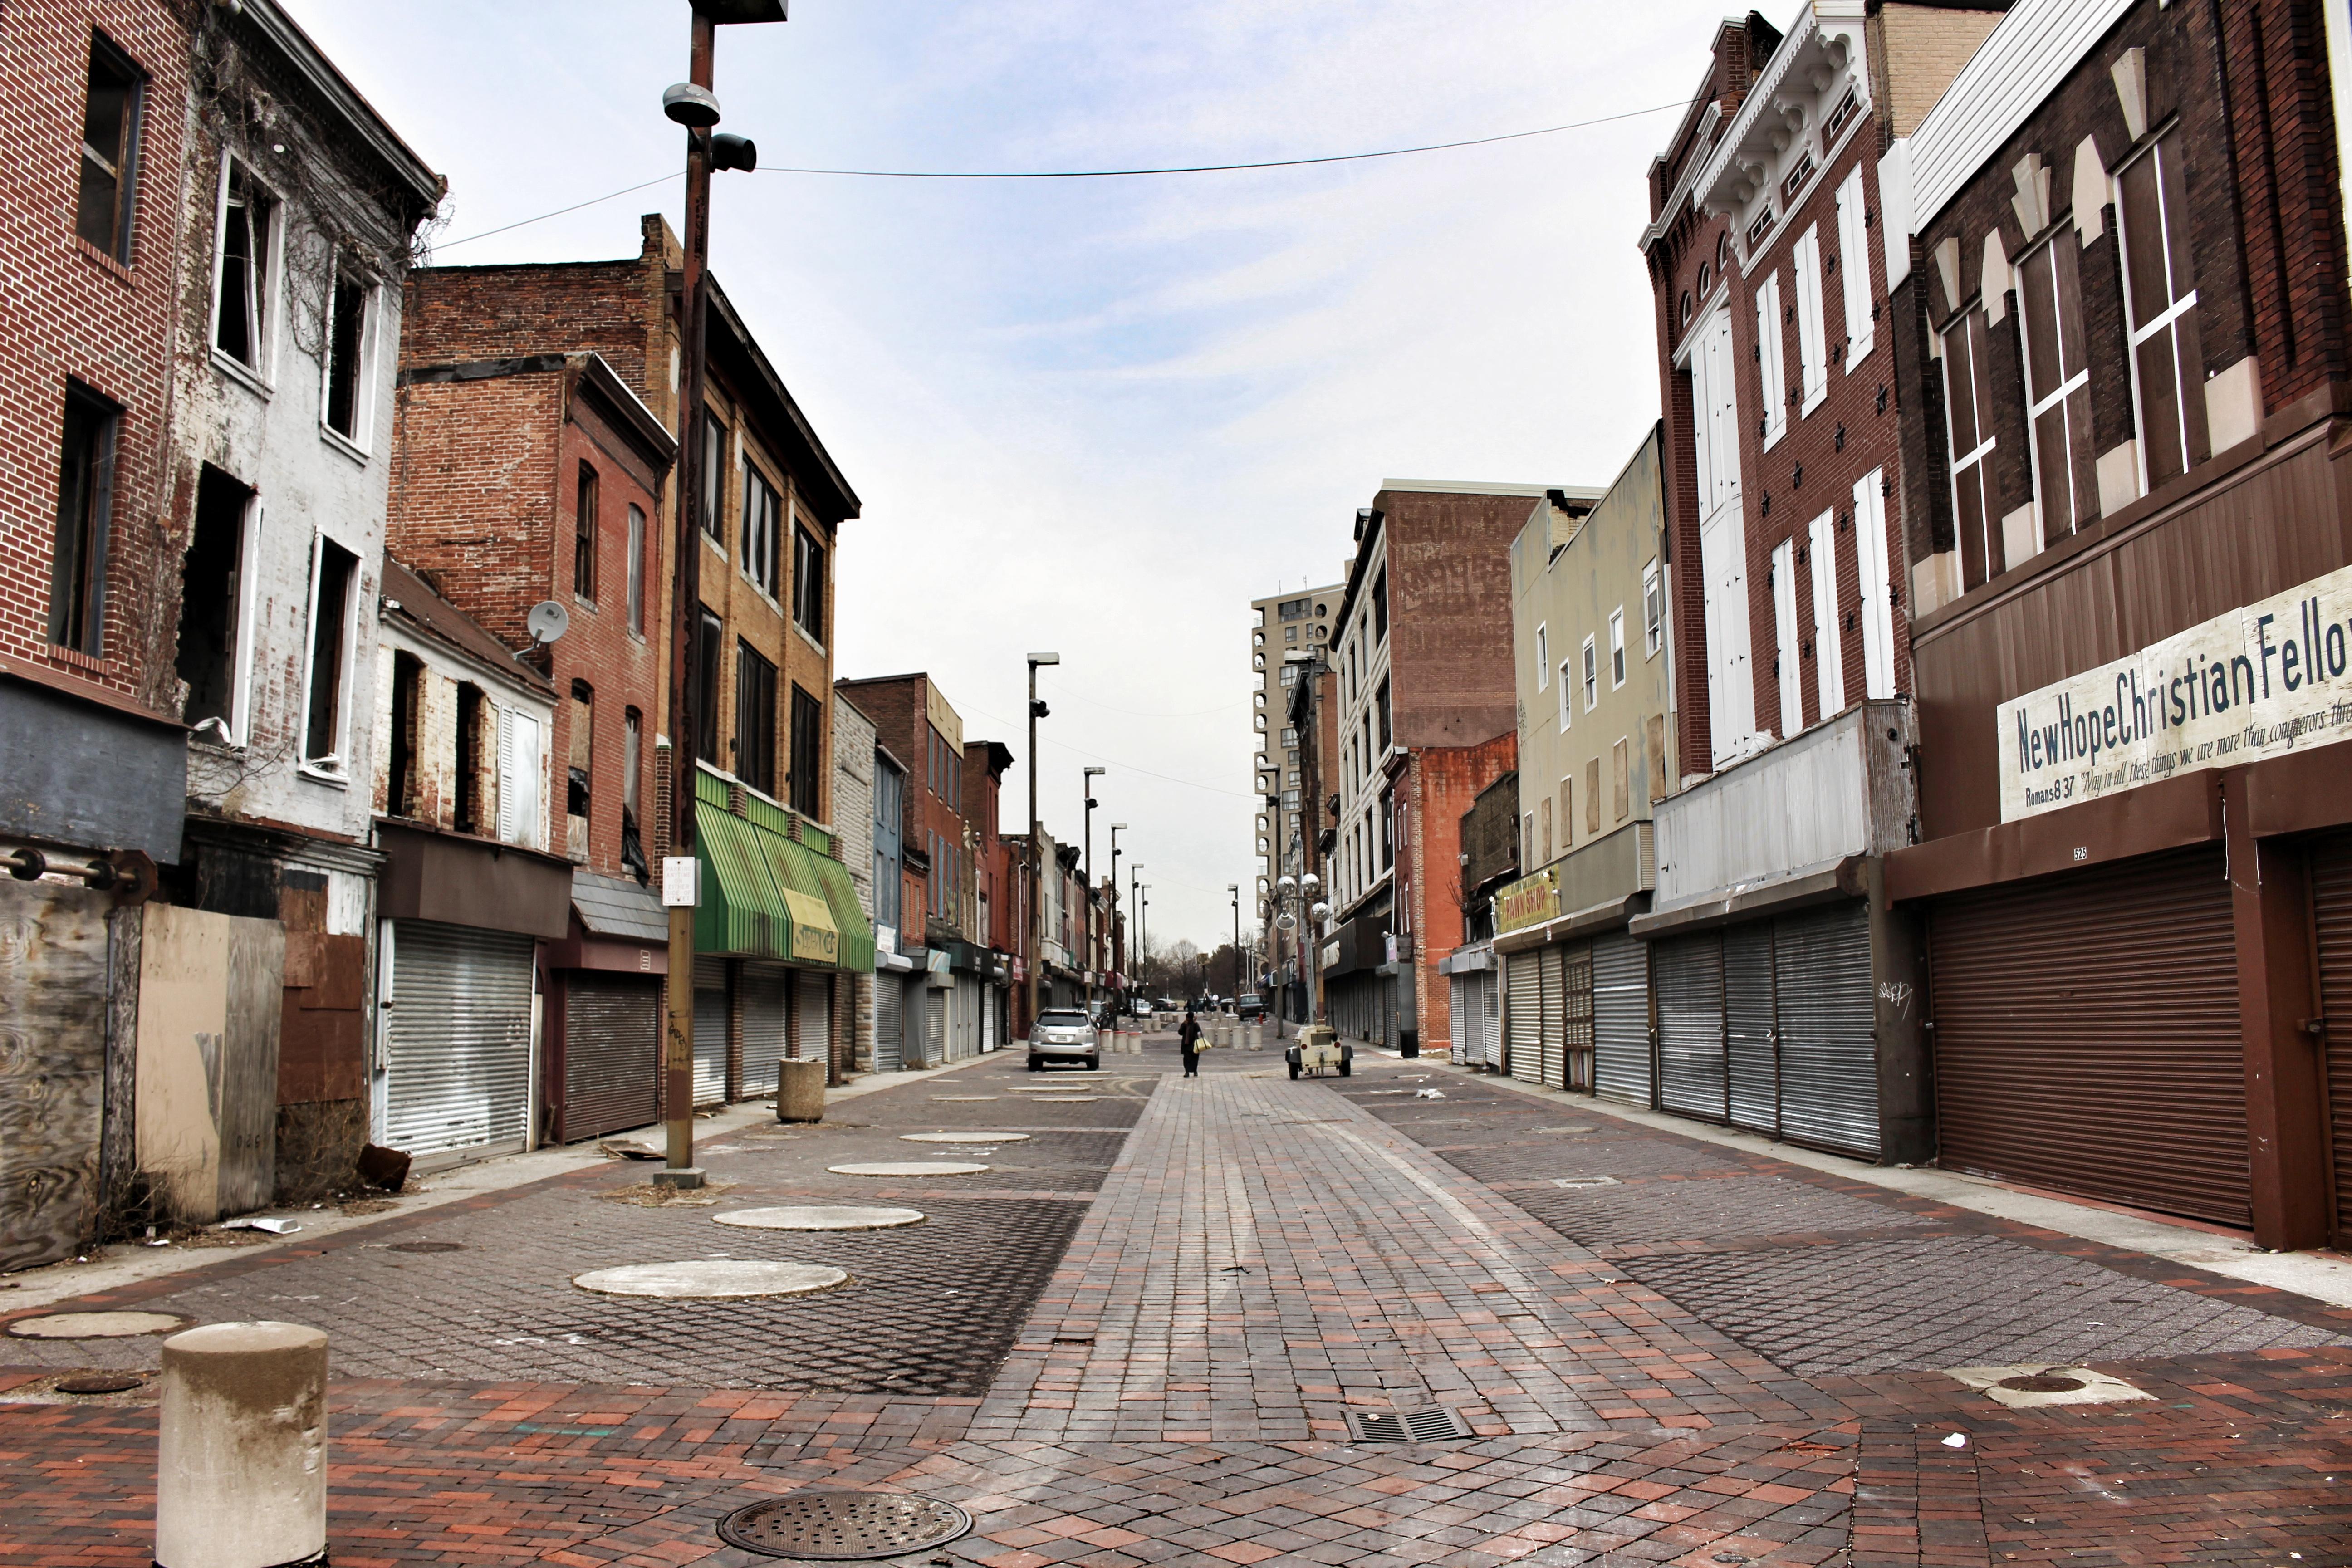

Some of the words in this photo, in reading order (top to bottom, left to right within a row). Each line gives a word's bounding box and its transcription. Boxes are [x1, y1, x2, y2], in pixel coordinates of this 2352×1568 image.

[2114, 759, 2127, 786] all
[2129, 758, 2150, 782] these
[2151, 750, 2176, 778] things
[2180, 746, 2193, 767] we
[2197, 741, 2213, 762] are
[2216, 733, 2240, 756] more
[2243, 722, 2266, 748] than
[2025, 787, 2054, 807] Romans
[2075, 847, 2086, 860] 525
[1506, 894, 1524, 921] PAWN
[1526, 885, 1546, 914] SHOP
